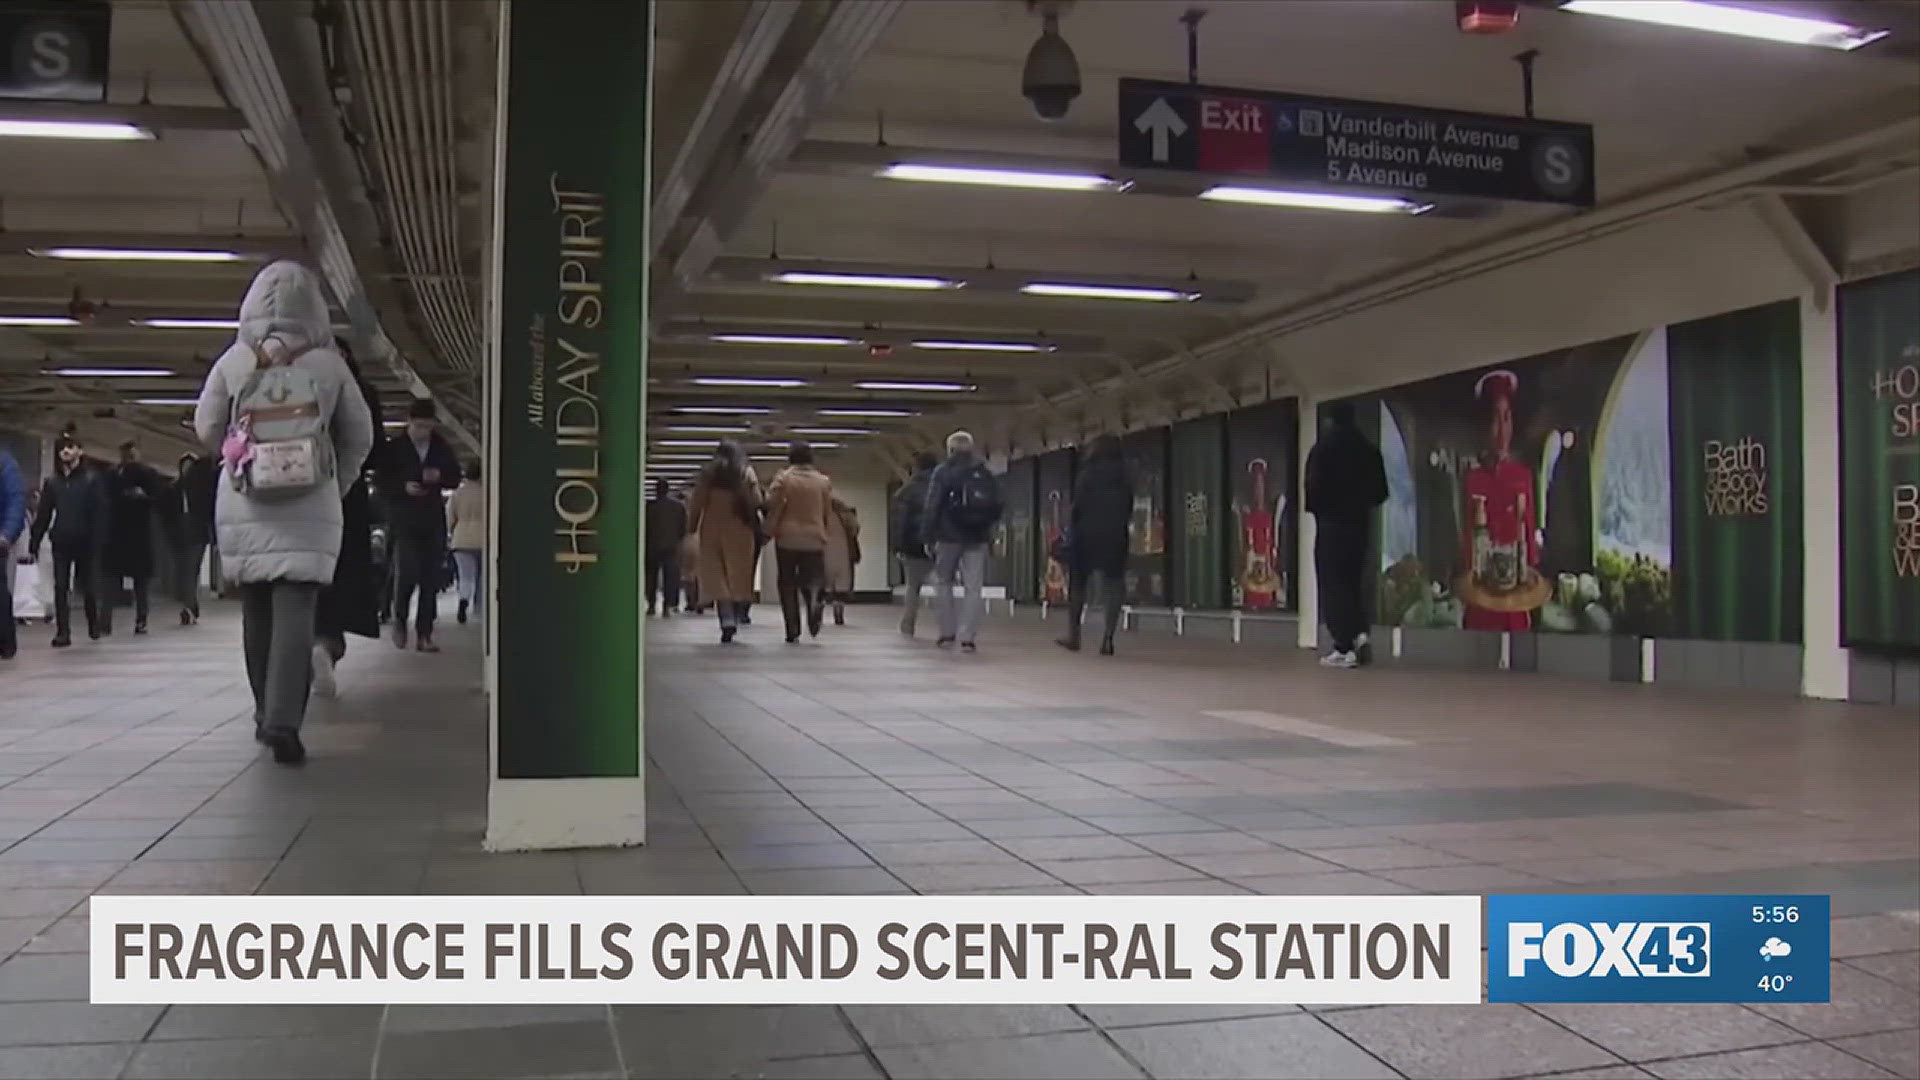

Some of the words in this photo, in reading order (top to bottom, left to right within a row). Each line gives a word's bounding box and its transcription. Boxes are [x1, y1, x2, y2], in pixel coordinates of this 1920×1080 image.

[31, 31, 70, 78] S
[1200, 101, 1263, 135] Exit
[1327, 112, 1437, 141] Vanderbilt
[1443, 123, 1520, 151] Avenue
[1326, 136, 1420, 164] Madison
[1426, 146, 1504, 172] Avenue
[1544, 145, 1573, 186] S
[1327, 159, 1342, 182] 5
[1346, 161, 1429, 188] Avenue
[550, 171, 605, 329] SPIRIT
[528, 403, 543, 428] All
[554, 337, 602, 574] HOLIDAY
[1704, 436, 1765, 472] Bath
